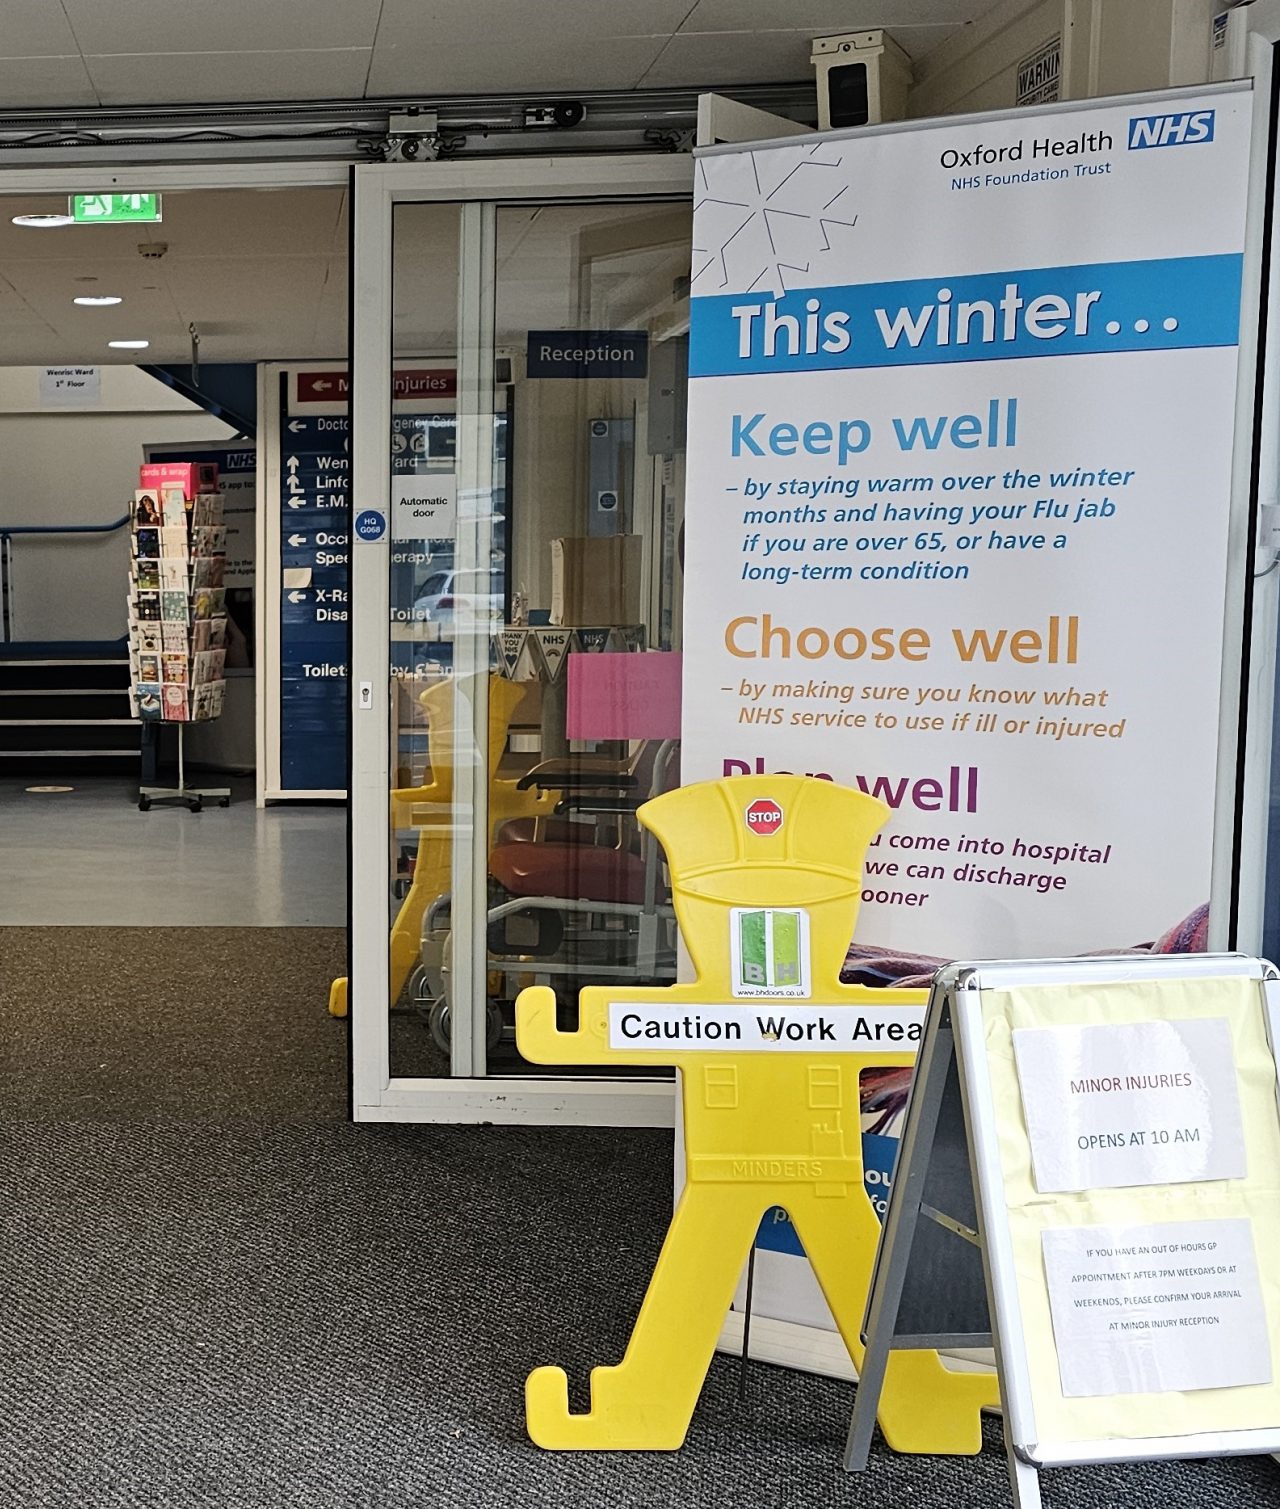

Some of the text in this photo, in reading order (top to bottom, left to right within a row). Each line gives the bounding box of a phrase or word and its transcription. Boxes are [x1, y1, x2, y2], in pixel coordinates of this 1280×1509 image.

[1020, 52, 1060, 96] WARNIN
[941, 110, 1215, 168] Oxford Health NHS
[952, 163, 1111, 190] NHS Foundation Trust
[730, 283, 1180, 359] This winter...
[539, 345, 635, 365] Reception
[75, 368, 94, 376] Ward
[732, 398, 1017, 465] Keep well
[228, 454, 256, 468] NHS
[392, 455, 418, 468] ard
[141, 467, 188, 477] cards & wrap
[744, 468, 1135, 500] by staying warm over the winter
[399, 497, 448, 506] Automatic
[744, 498, 1115, 525] months and having your Flu jab
[413, 509, 435, 518] door
[360, 526, 381, 534] G068
[743, 531, 1066, 556] if you are over 65, or have a
[742, 561, 968, 584] long-term condition
[316, 589, 348, 602] X-Ra
[390, 607, 432, 621] Toilet
[543, 635, 565, 645] NHS
[584, 634, 604, 644] NHS
[725, 614, 1078, 663] Choose well
[302, 663, 348, 677] Toilet
[739, 679, 1108, 707] by making sure you know what
[739, 707, 1126, 740] NHS service to use if ill or injured
[856, 765, 979, 814] well
[748, 812, 781, 823] STOP
[890, 835, 950, 851] come
[958, 835, 1004, 855] into
[1012, 838, 1111, 864] hospital
[866, 862, 1066, 893] we can discharge
[860, 887, 929, 907] ooner
[737, 989, 806, 998] www.bhdoors.co.uk
[620, 1013, 921, 1041] Caution Work Area
[1070, 1073, 1192, 1094] MINOR INJURIES
[1078, 1128, 1200, 1150] OPENS AT 10 AM
[732, 1160, 823, 1178] MINDERS
[1086, 1242, 1218, 1258] IF YOU HAVE AN OUT OF HOURS GP
[1071, 1265, 1237, 1283] APPOINTMENT AFTER 7PM WEEKDAYS OR AT
[1073, 1290, 1242, 1308] WEEKENDS, PLEASE CONFIRM YOUR ARRIVAL
[1109, 1316, 1220, 1331] AT MINOR INJURY RECEPTION
